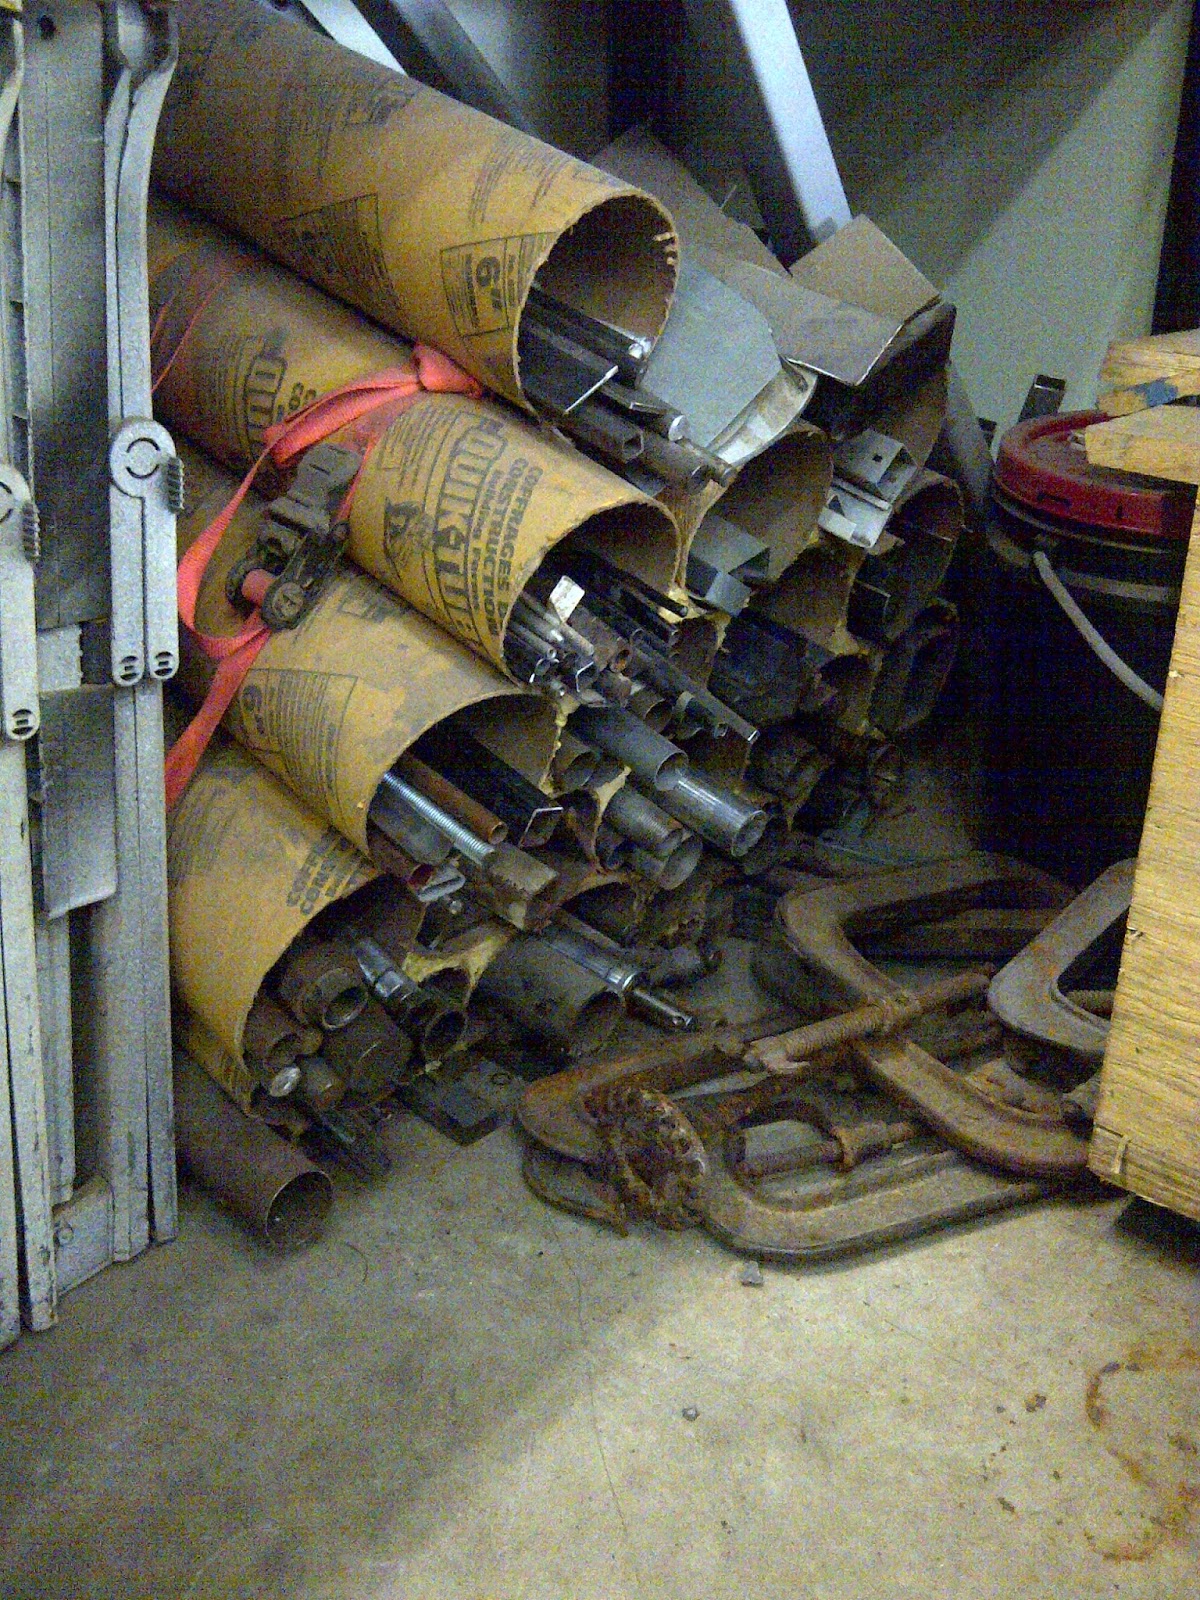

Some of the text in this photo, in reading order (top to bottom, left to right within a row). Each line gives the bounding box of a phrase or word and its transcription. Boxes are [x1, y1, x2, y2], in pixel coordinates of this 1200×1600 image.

[431, 427, 508, 638] QUIK-TUB
[483, 458, 529, 636] CONSTRUCTION
[498, 466, 543, 591] COFFRAGES
